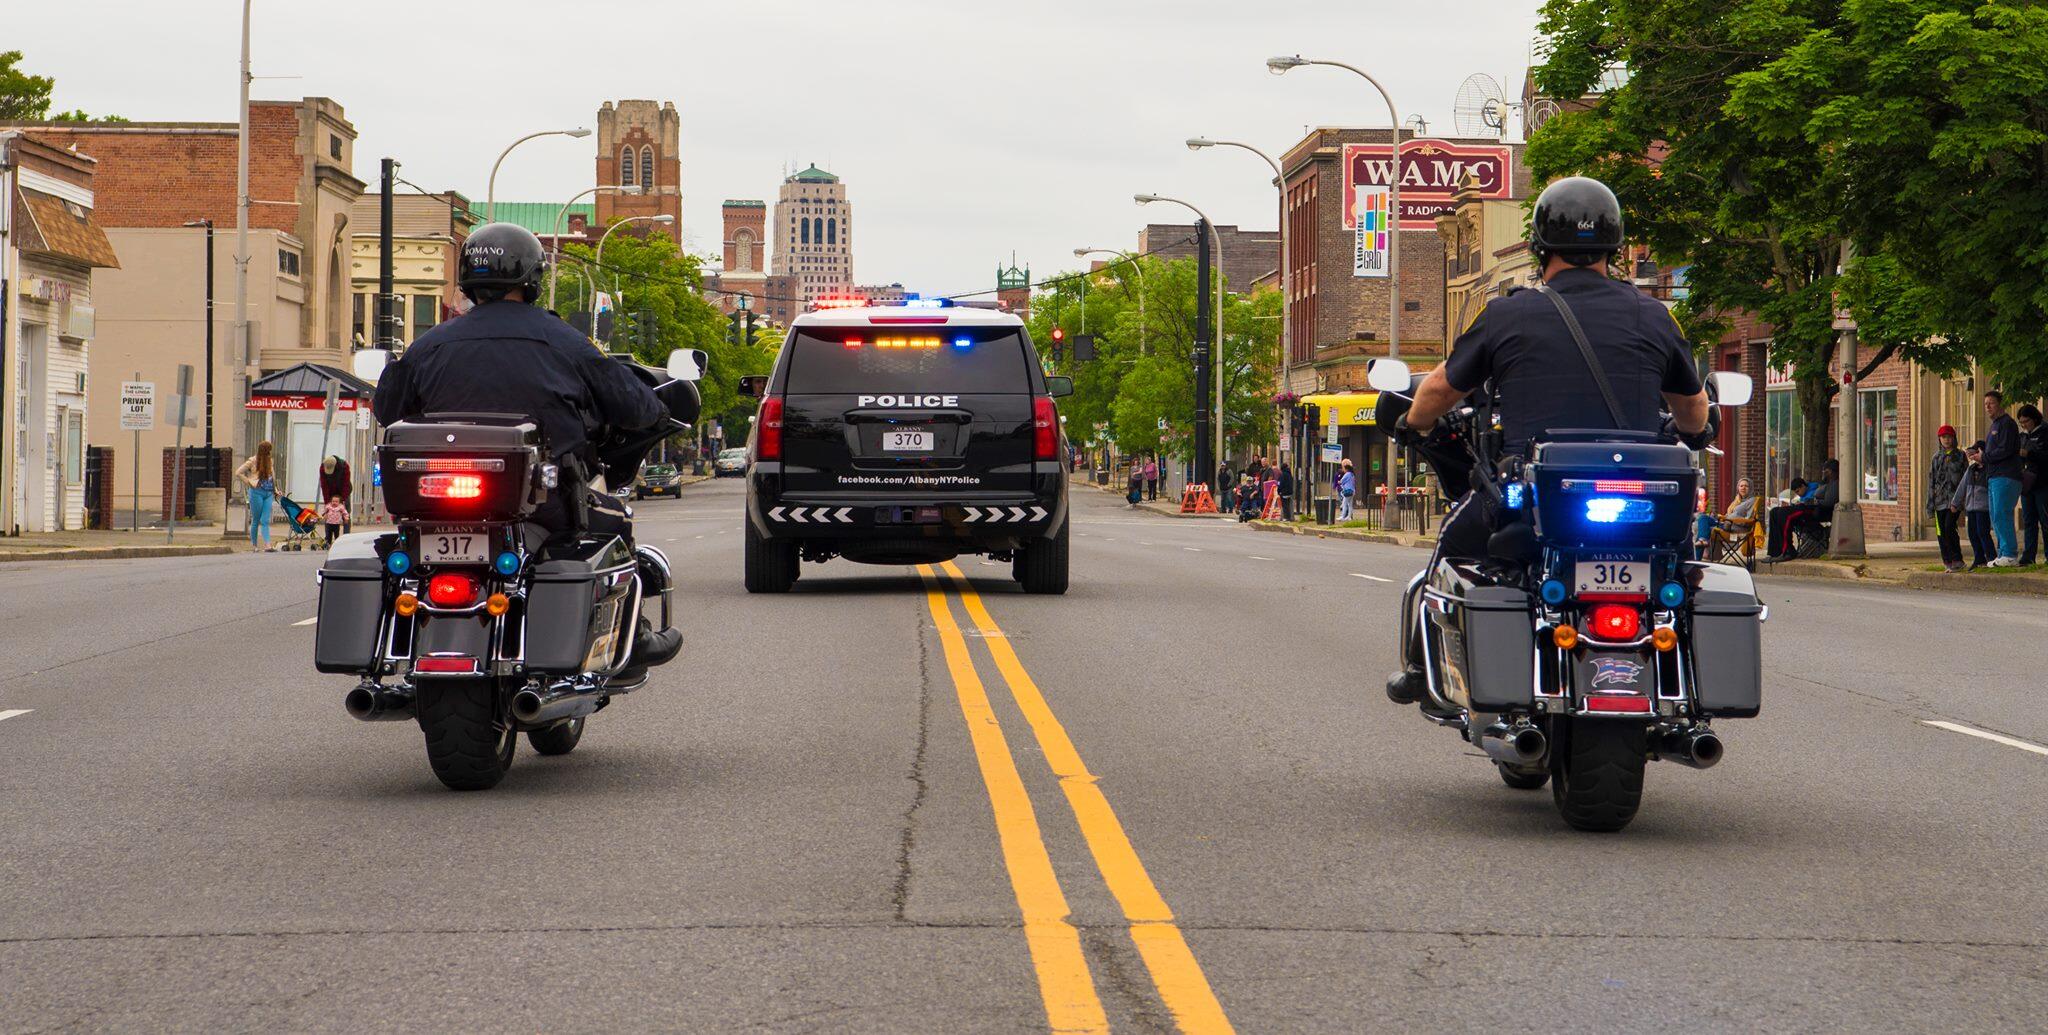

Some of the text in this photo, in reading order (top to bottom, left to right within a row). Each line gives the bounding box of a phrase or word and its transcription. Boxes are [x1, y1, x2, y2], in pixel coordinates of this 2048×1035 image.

[1363, 159, 1494, 187] WAMC
[1577, 220, 1594, 230] 664
[465, 247, 504, 256] ROMANO
[474, 257, 488, 266] 516
[1364, 250, 1382, 269] GRID
[122, 397, 152, 405] PRIVATE
[858, 395, 958, 407] POLICE
[895, 433, 922, 446] 370
[838, 475, 980, 486] facebook.com/AlbanyNYPolice
[437, 536, 473, 555] 317
[1593, 564, 1633, 584] 316
